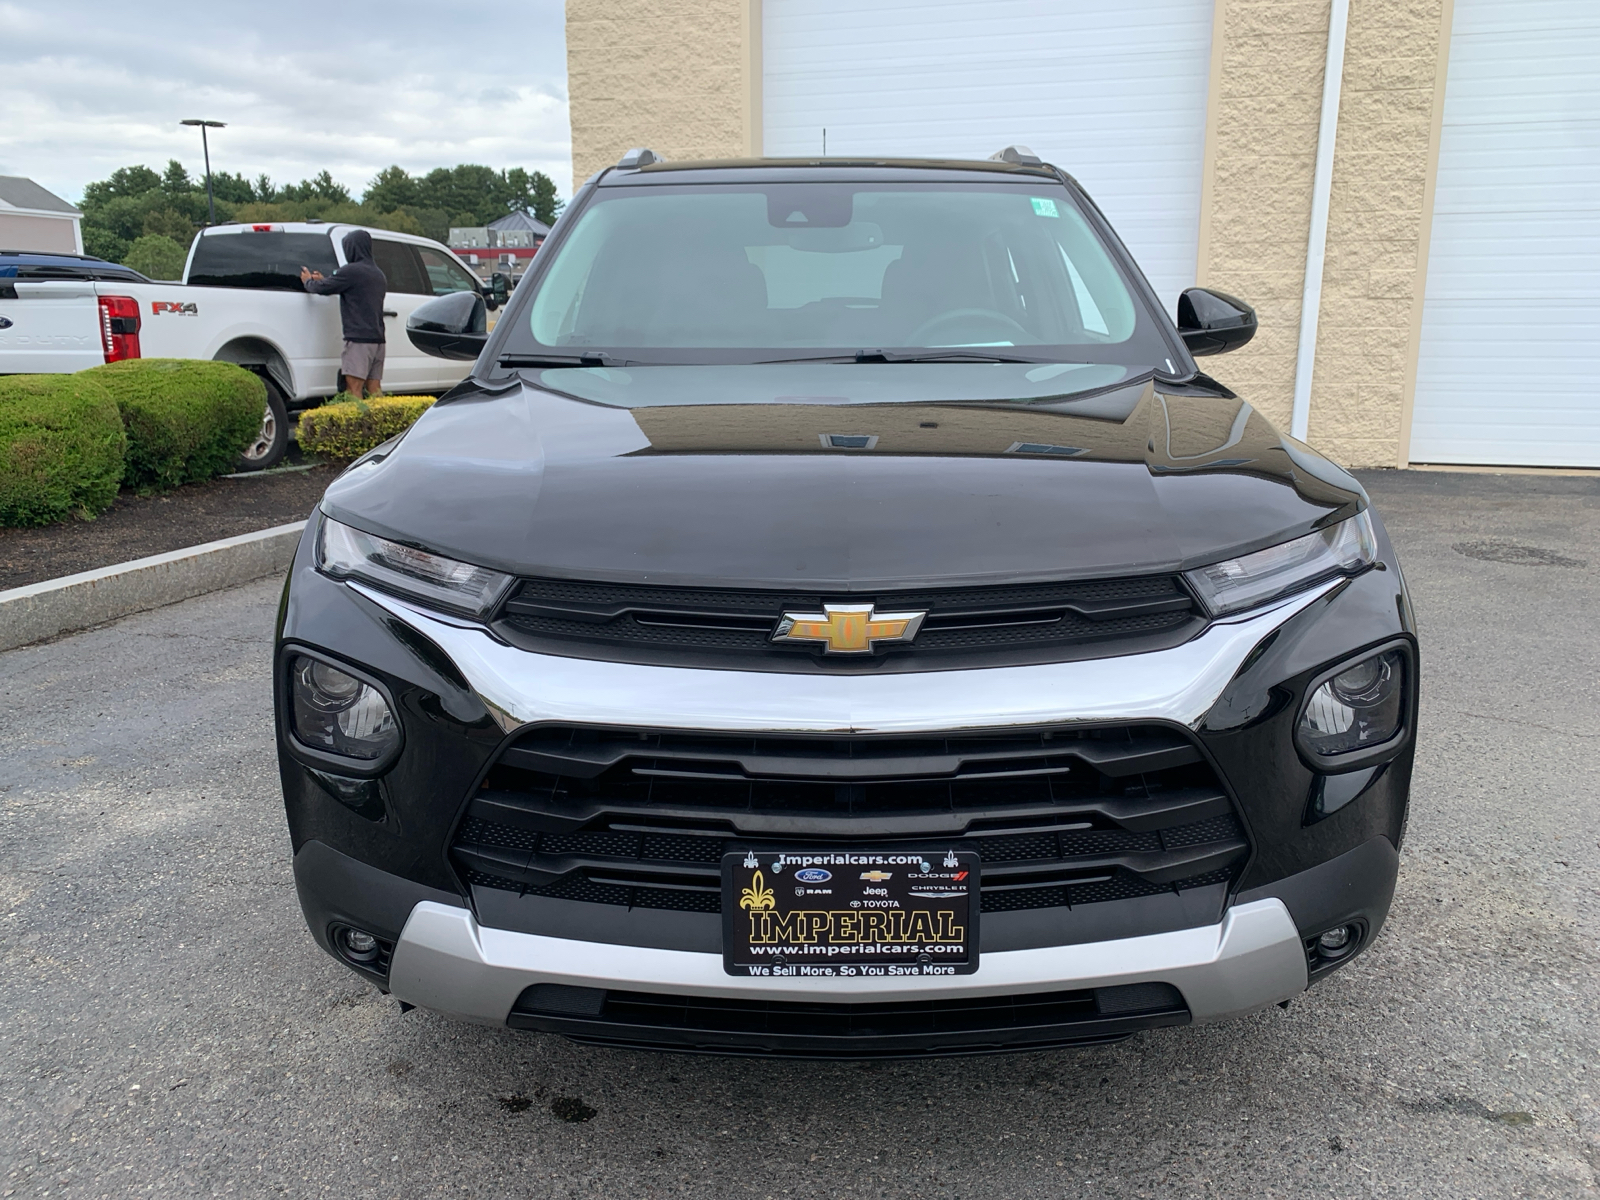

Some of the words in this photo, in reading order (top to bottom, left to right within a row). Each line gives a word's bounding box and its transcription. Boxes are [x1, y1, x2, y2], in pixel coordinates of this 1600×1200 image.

[151, 301, 198, 315] FX4
[779, 853, 923, 867] Imperialcars.com
[802, 871, 824, 880] Ford
[863, 886, 888, 897] Jeep
[863, 900, 900, 908] TOYOTA
[749, 910, 964, 944] IMPERIAL
[749, 943, 964, 956] www.imperialcars.com
[749, 966, 770, 976] We
[773, 965, 796, 976] Sell
[800, 966, 836, 977] More,
[840, 965, 857, 976] So
[860, 965, 885, 975] You
[888, 965, 919, 975] Save
[923, 965, 955, 975] More
